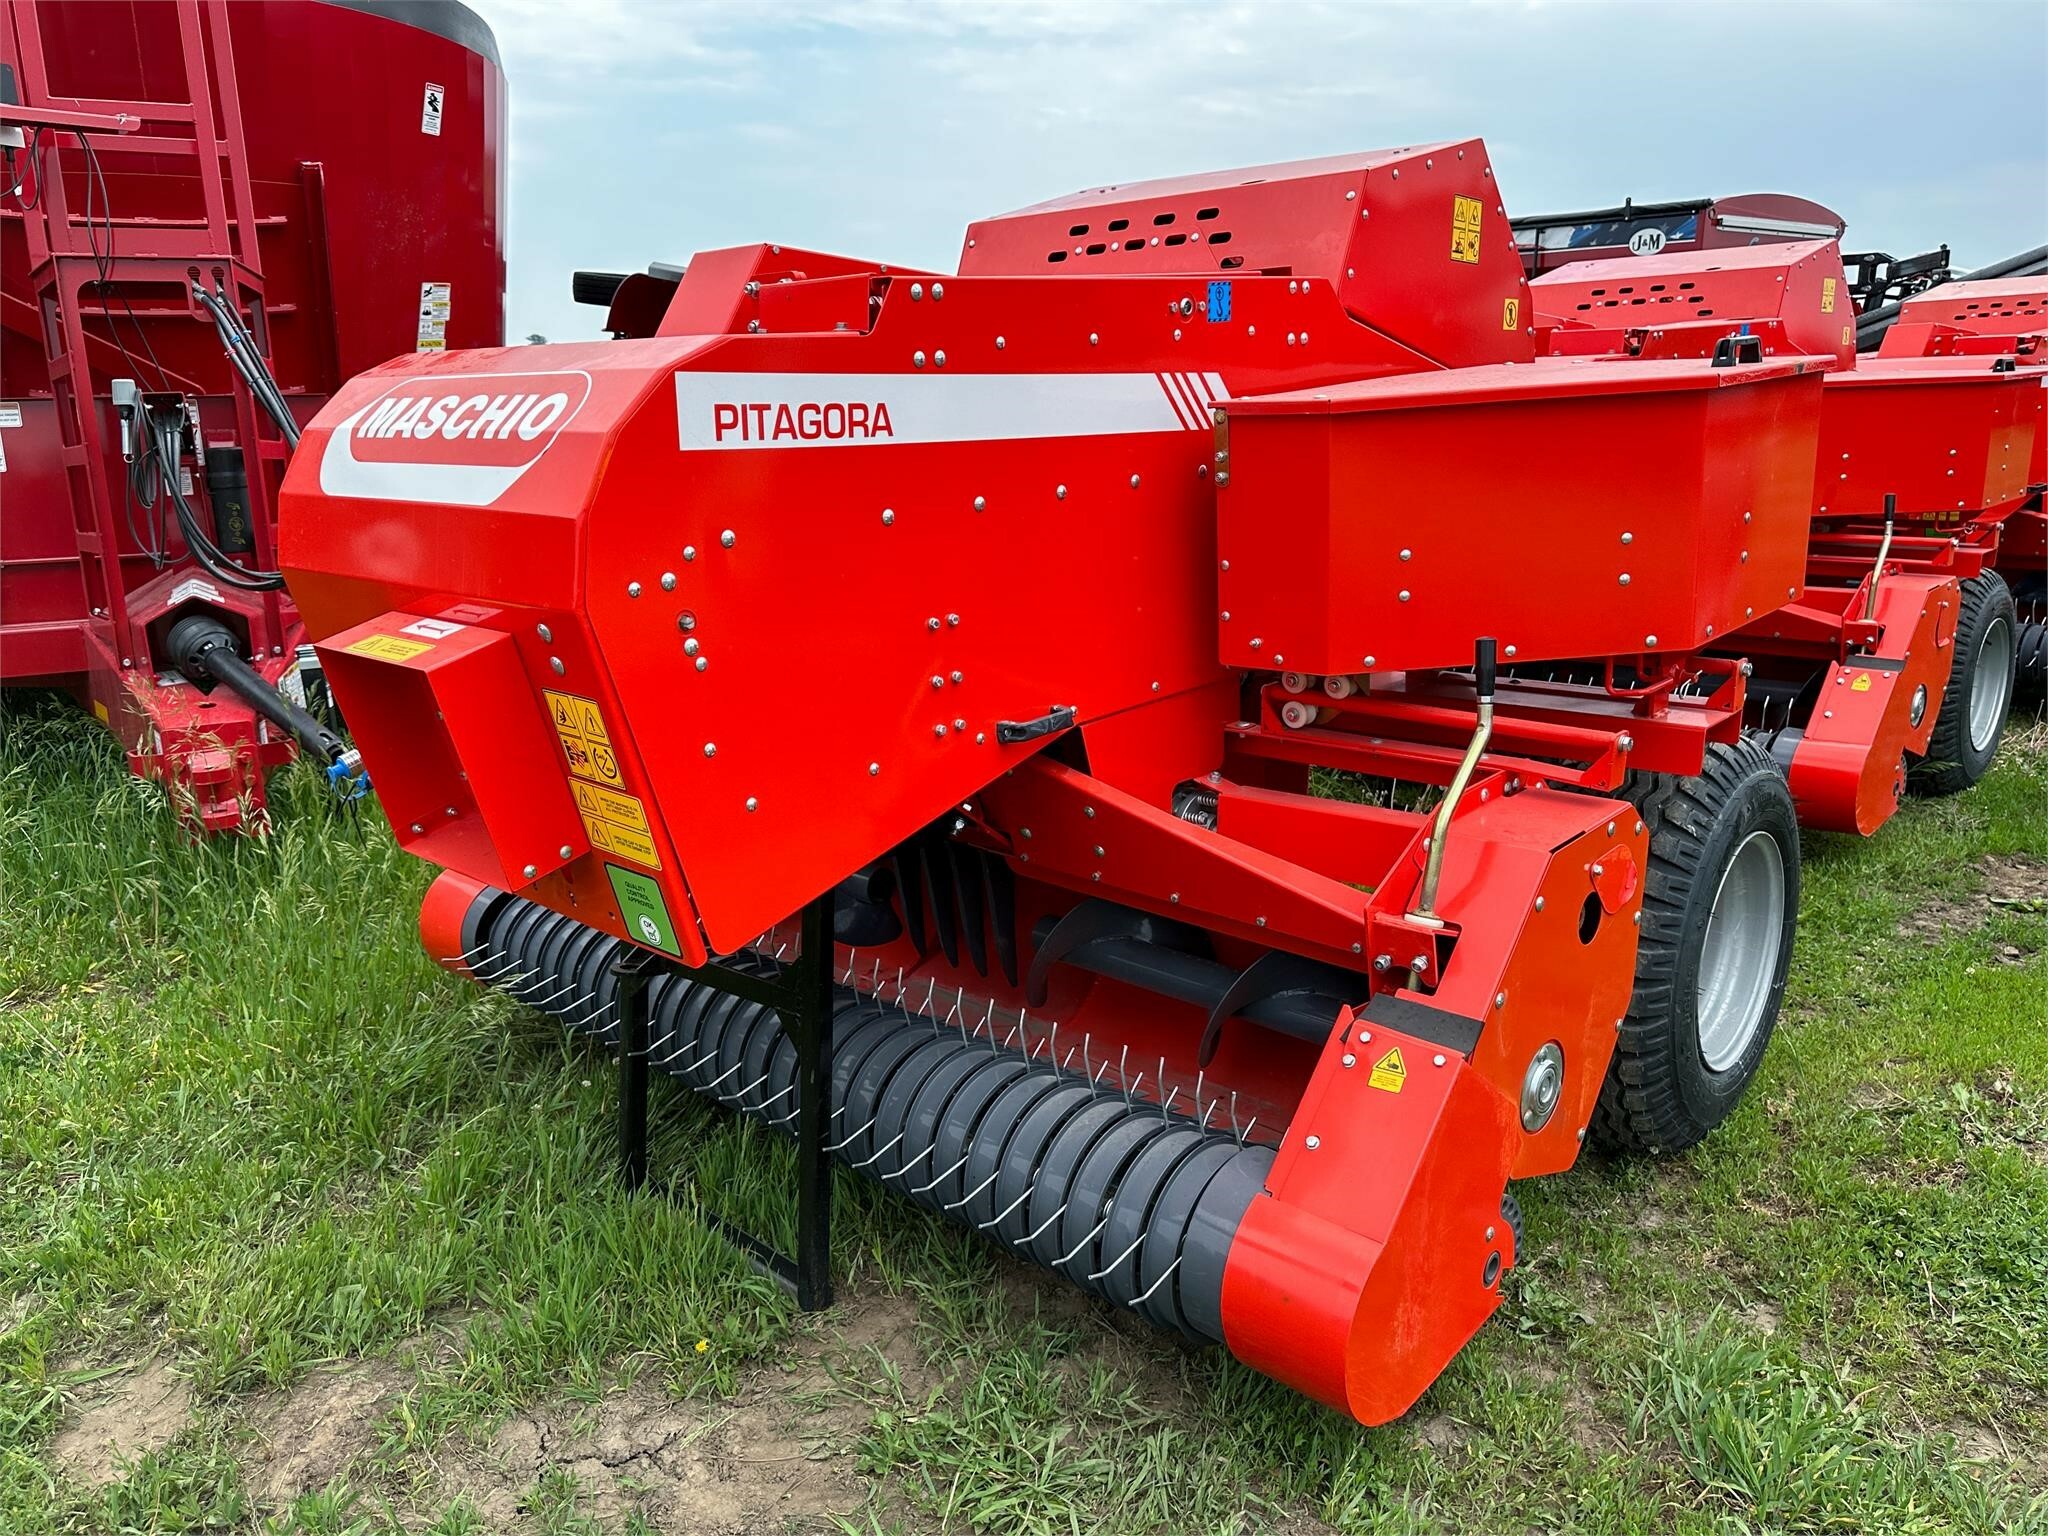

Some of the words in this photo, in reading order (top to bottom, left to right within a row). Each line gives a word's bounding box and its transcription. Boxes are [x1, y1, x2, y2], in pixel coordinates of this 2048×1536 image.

[1632, 233, 1662, 251] J&M
[356, 392, 569, 441] MASCHIO
[713, 402, 894, 441] PITAGORA
[625, 881, 646, 893] QUALITY
[626, 888, 651, 902] CONTROL
[627, 896, 655, 910] APPROVED
